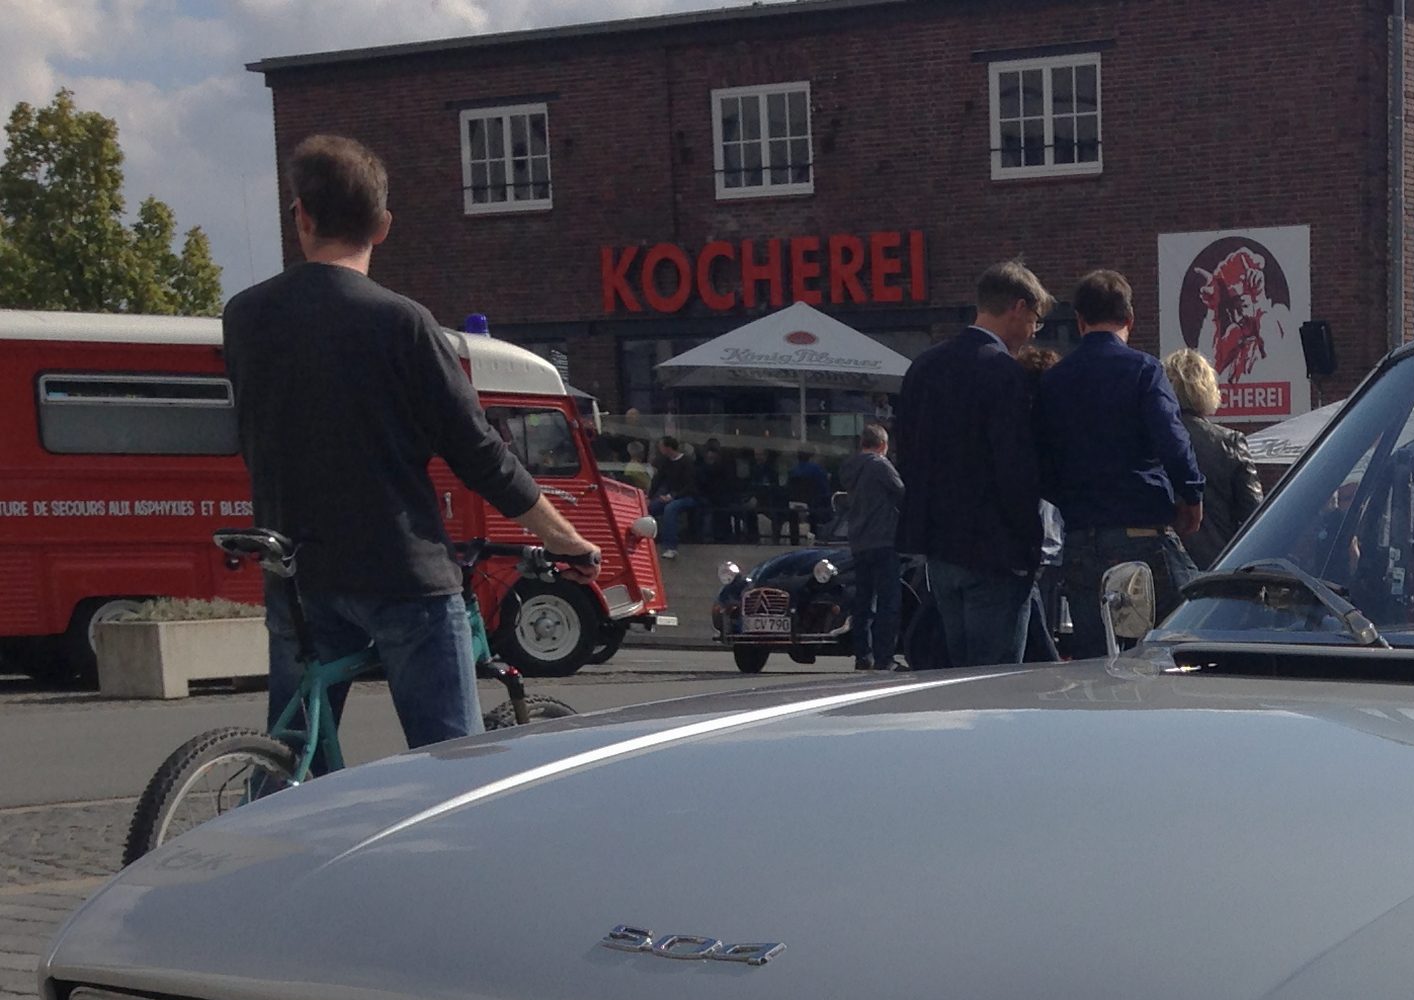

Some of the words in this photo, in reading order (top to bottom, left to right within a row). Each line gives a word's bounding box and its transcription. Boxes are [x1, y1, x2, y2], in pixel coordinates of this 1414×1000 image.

[602, 230, 926, 313] KOCHEREI
[1220, 387, 1283, 409] CHEREI
[33, 501, 49, 517] DE
[51, 501, 105, 517] SECOURS
[108, 501, 132, 517] AUX
[134, 501, 195, 517] ASPHYXIES
[201, 501, 215, 517] ET
[602, 924, 788, 966] 504
